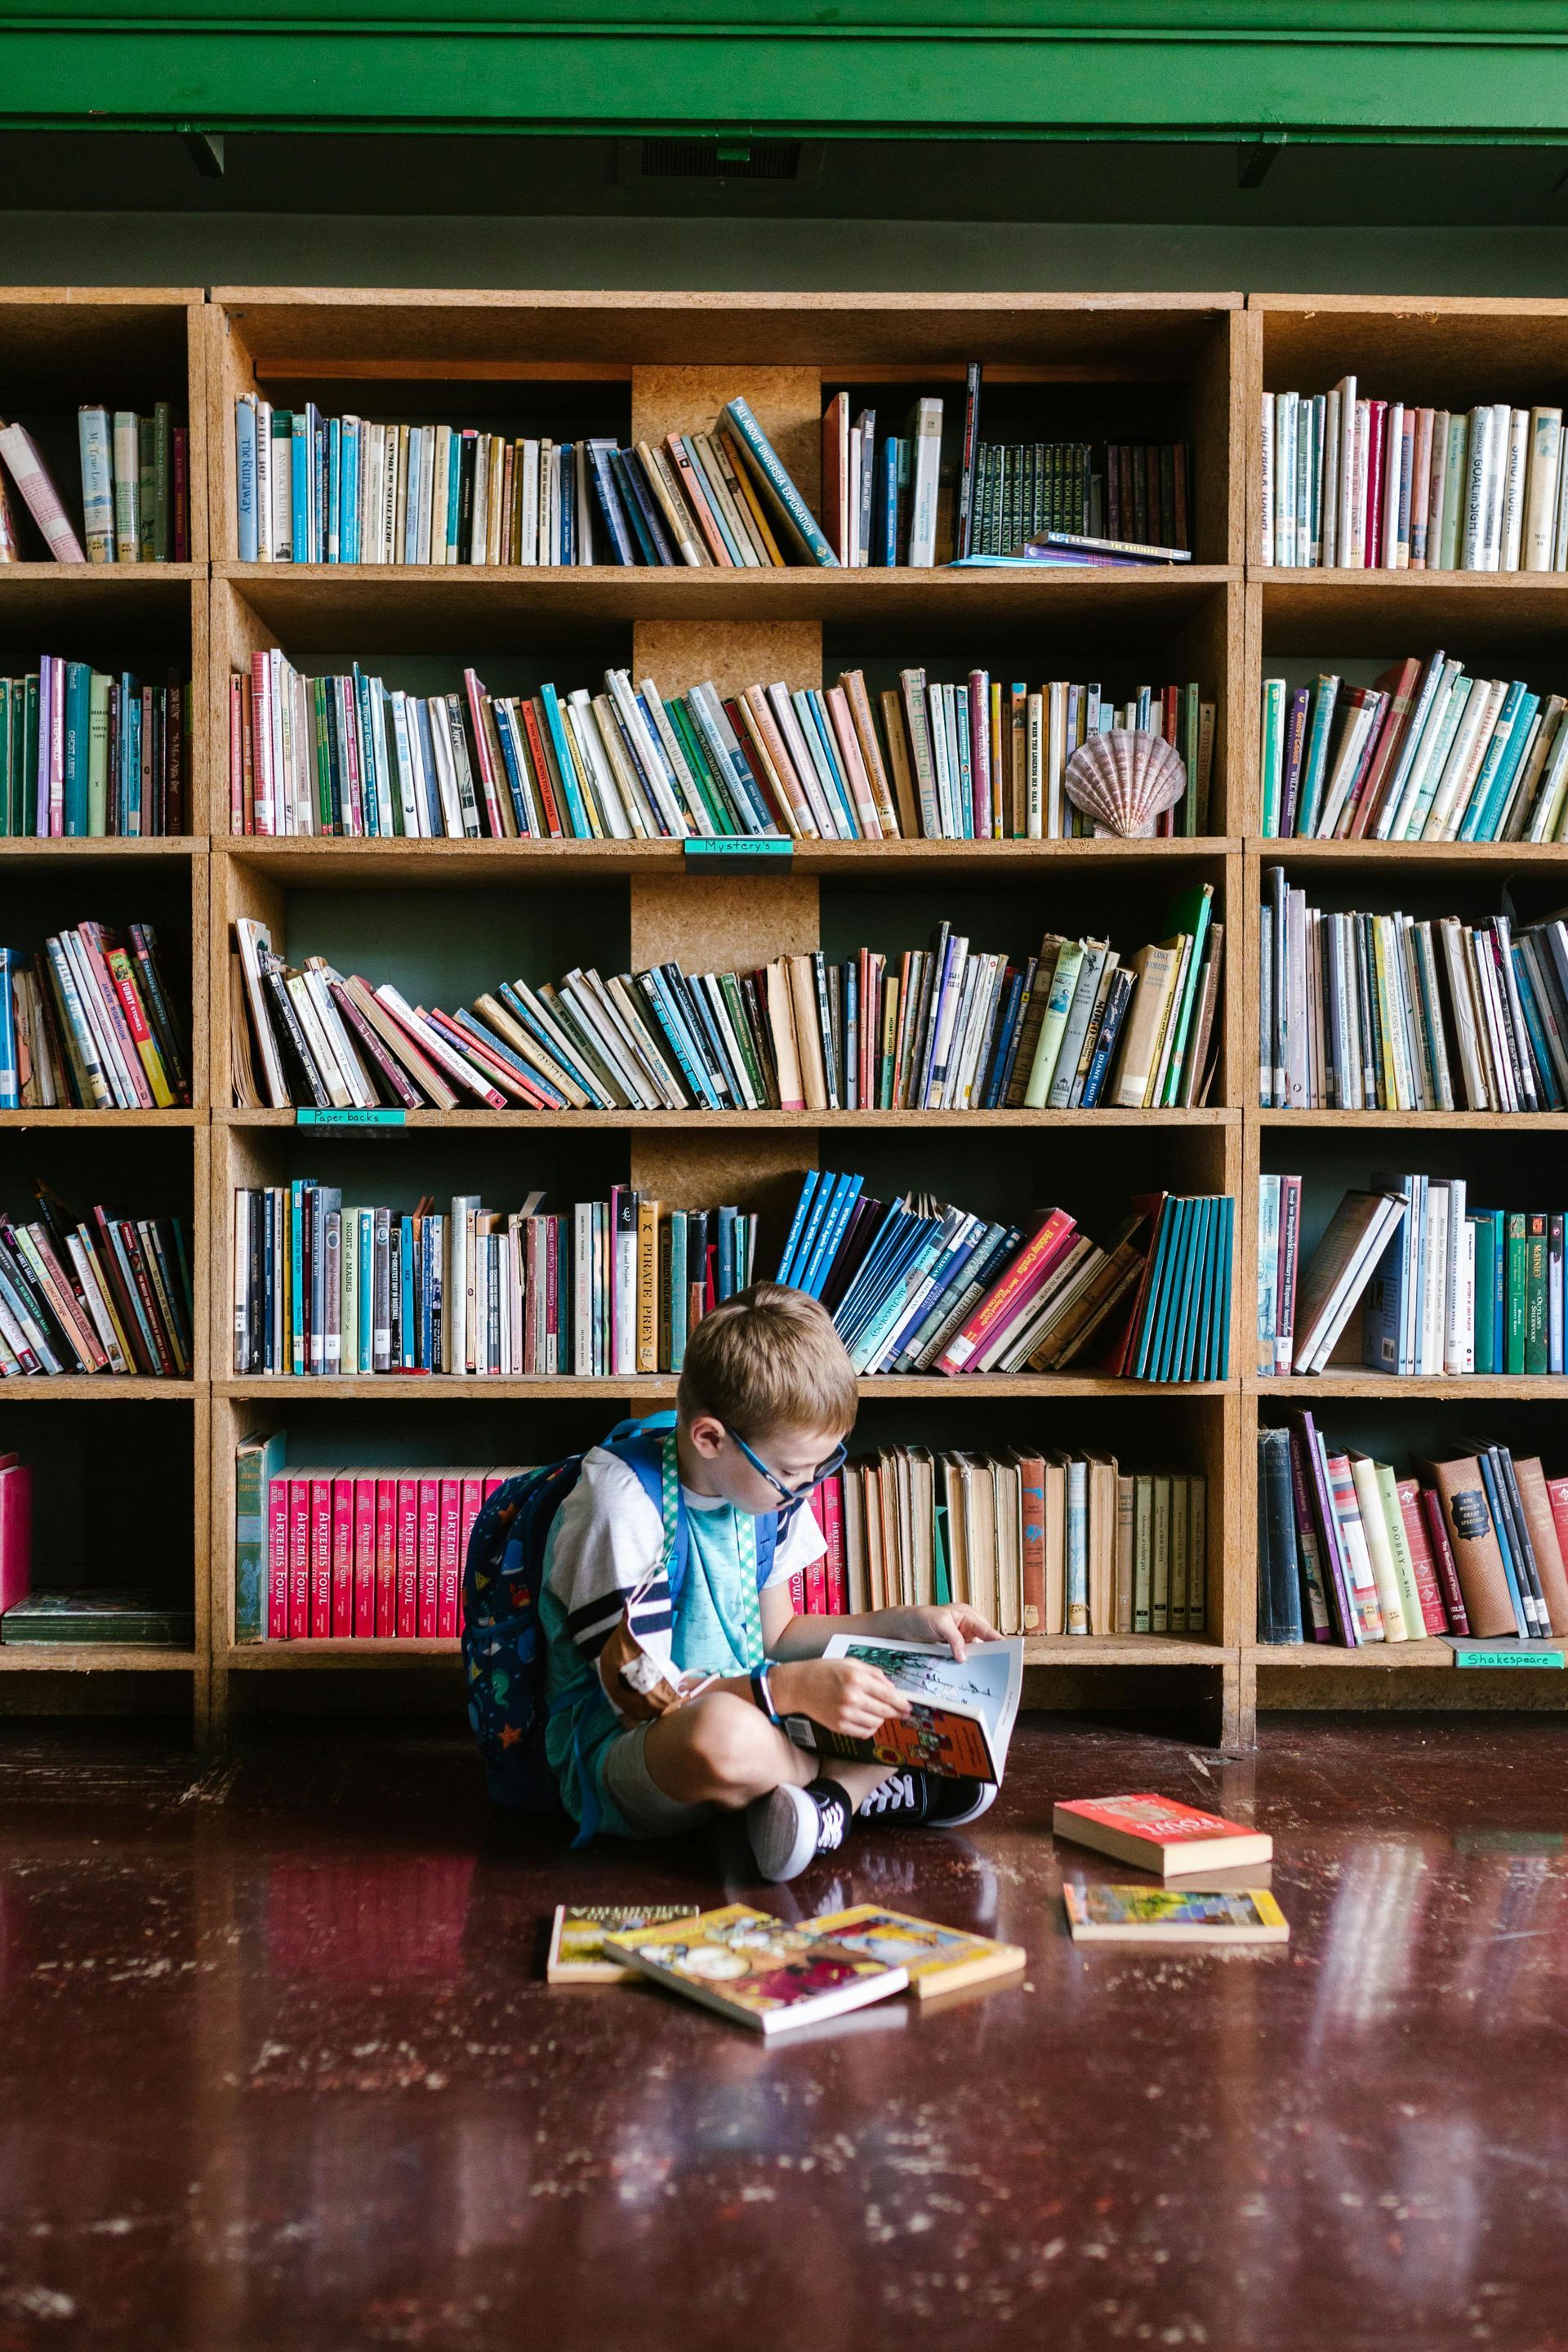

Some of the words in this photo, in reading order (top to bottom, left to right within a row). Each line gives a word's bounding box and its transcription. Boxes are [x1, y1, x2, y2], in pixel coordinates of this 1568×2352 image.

[88, 432, 98, 445] My
[865, 421, 873, 438] JAPAN
[89, 448, 100, 470] True
[242, 438, 252, 458] The
[91, 471, 101, 492] Love
[734, 405, 745, 420] ALL
[741, 419, 759, 444] ABOUT
[758, 445, 785, 487] UNDERSEA
[782, 487, 815, 536] EXPLORATION
[1472, 459, 1482, 492] GOAL
[240, 461, 252, 515] Runaway
[983, 481, 991, 514] WOODS
[1472, 493, 1479, 501] in
[93, 495, 101, 519] Waits
[1469, 504, 1479, 537] SIGHT
[695, 697, 705, 713] BOYNE
[751, 692, 764, 713] SCHOLZ
[911, 678, 924, 707] The
[528, 723, 537, 737] Irene
[1480, 705, 1498, 736] LITTLE
[532, 738, 540, 752] Hunt
[915, 714, 927, 758] Island
[761, 719, 778, 749] FIELDER
[773, 750, 788, 770] FROM
[782, 771, 801, 806] NOWHERE
[1468, 738, 1486, 773] LEAGUE
[721, 761, 732, 780] STRIPED
[732, 781, 744, 801] PAJAMAS
[918, 764, 927, 779] of
[1290, 770, 1298, 791] WILL
[537, 757, 545, 779] ACROSS
[545, 796, 554, 817] APRILS
[1455, 777, 1472, 808] AMIGO
[921, 790, 937, 838] Horses
[1286, 791, 1295, 816] HOBBS
[706, 840, 770, 852] Mystery's
[143, 960, 157, 992] TREASURE
[153, 995, 167, 1024] HUNTERS
[101, 982, 114, 1004] JACKIE
[110, 1007, 126, 1040] ROBINSON
[122, 982, 136, 1005] FUNNY
[131, 1006, 143, 1031] STORIES
[417, 1025, 439, 1046] SAVAGE
[437, 1045, 474, 1080] INEQUALITIES
[1090, 1054, 1105, 1080] DIANE
[1086, 1083, 1099, 1102] HOH
[795, 1204, 804, 1221] Many
[811, 1205, 823, 1224] Handle
[826, 1219, 834, 1229] Me
[830, 1207, 838, 1218] Ask
[839, 1207, 850, 1227] Within
[787, 1222, 800, 1243] People,
[806, 1226, 816, 1241] With
[819, 1230, 830, 1247] Again
[835, 1227, 842, 1237] My
[1031, 1229, 1054, 1254] Holiday
[1285, 1216, 1294, 1249] Biographical
[346, 1252, 353, 1260] of
[783, 1245, 793, 1261] Many
[801, 1241, 810, 1254] Care
[828, 1238, 840, 1254] Reach
[16, 1253, 29, 1268] JAMES
[23, 1268, 37, 1284] SALLIS
[643, 1244, 653, 1297] PIRATE
[777, 1263, 789, 1281] Voices
[809, 1249, 824, 1276] Tomorrow
[932, 1250, 952, 1278] MEXICAN
[1016, 1253, 1039, 1274] Crafts
[1285, 1250, 1294, 1276] Dictionary
[46, 1281, 68, 1316] superfudge
[944, 1286, 982, 1331] BUTTERFLIES
[1283, 1285, 1291, 1307] Hispanic
[643, 1305, 653, 1344] PREY
[1282, 1307, 1290, 1336] Americans
[938, 1330, 950, 1343] AND
[918, 1341, 942, 1368] MOTHS
[1292, 1440, 1301, 1469] Children
[1295, 1471, 1308, 1512] Everywhere
[834, 1563, 842, 1586] FOWL
[1391, 1526, 1405, 1565] DOBRY
[1403, 1581, 1411, 1598] WING
[275, 1572, 286, 1606] FOWL
[296, 1572, 307, 1604] FOWL
[319, 1572, 329, 1605] FOWL
[405, 1572, 415, 1605] FOWL
[426, 1572, 436, 1606] FOWL
[446, 1570, 457, 1604] FOWL
[1444, 1552, 1454, 1576] Merchant
[1450, 1583, 1458, 1601] Venice
[1468, 1655, 1548, 1666] Shakespeare
